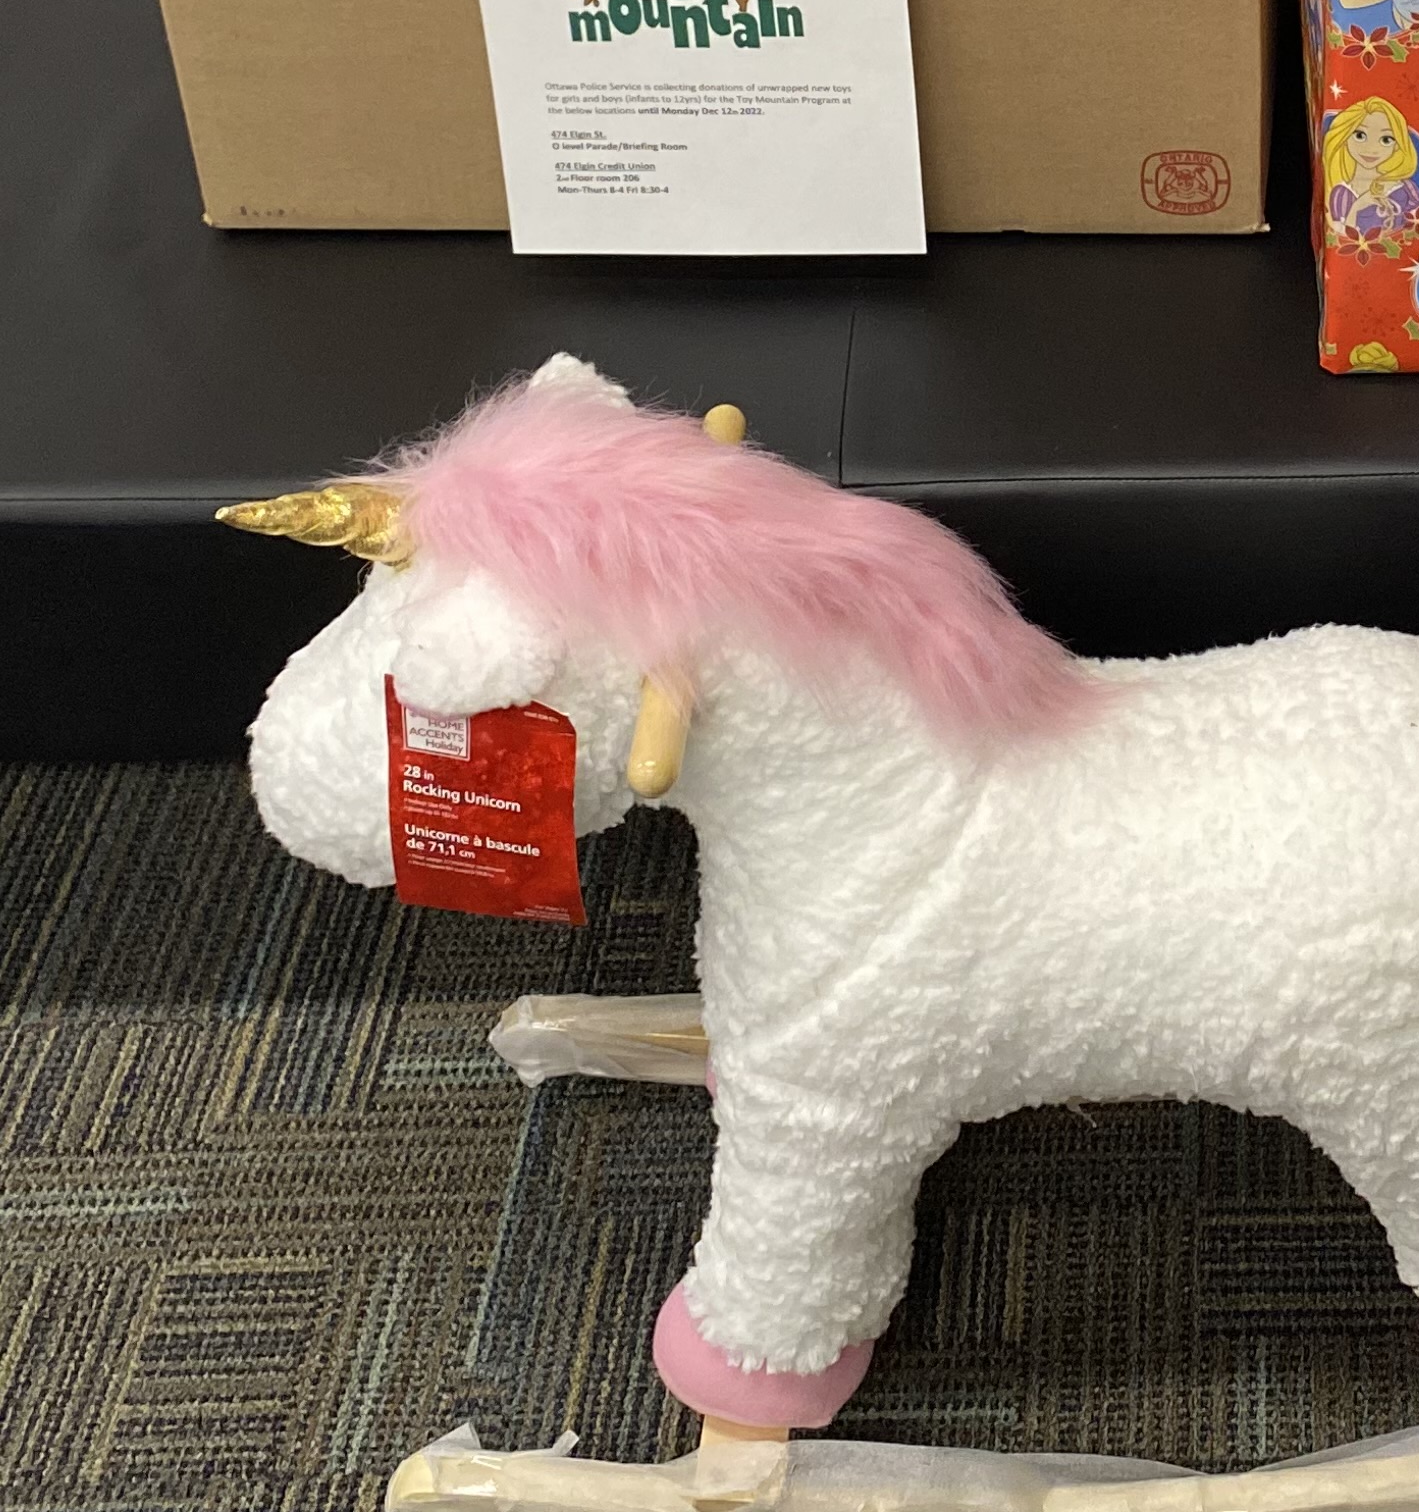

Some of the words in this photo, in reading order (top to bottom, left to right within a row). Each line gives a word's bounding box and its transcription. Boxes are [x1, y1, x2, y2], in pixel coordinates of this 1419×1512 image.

[544, 82, 578, 91] Ottawa
[580, 82, 607, 91] Police
[609, 83, 642, 91] Service
[644, 83, 652, 91] is
[653, 83, 697, 93] collecting
[699, 83, 744, 92] donations
[745, 83, 755, 92] of
[757, 84, 809, 93] unwrapped
[832, 85, 852, 94] toys
[546, 95, 559, 103] for
[561, 95, 580, 104] girls
[582, 95, 600, 103] and
[601, 95, 623, 104] boys
[625, 95, 660, 104] (infants
[674, 95, 702, 104] 12yrs)
[704, 95, 717, 103] for
[719, 95, 734, 103] the
[736, 96, 753, 105] Toy
[755, 96, 799, 104] Mountain
[801, 96, 840, 105] Program
[842, 97, 852, 105] at
[594, 107, 636, 115] locations
[638, 107, 660, 115] until
[661, 107, 700, 116] Monday
[551, 130, 568, 139] 474
[569, 130, 592, 140] Elgin
[593, 130, 608, 139] St.
[562, 142, 584, 150] level
[585, 142, 659, 152] Parade/Briefing
[660, 143, 688, 151] Room
[1159, 152, 1213, 164] ONTARIO
[554, 162, 572, 171] 474
[573, 162, 596, 171] Elgin
[597, 162, 625, 171] Credit
[627, 162, 656, 171] Union
[570, 174, 594, 182] Floor
[623, 174, 640, 182] 206
[557, 186, 608, 194] Mon-Thurs
[626, 186, 638, 194] Fri
[427, 718, 465, 732] HOME
[409, 726, 465, 743] ACCENTS
[425, 738, 464, 756] Holiday
[403, 764, 421, 779] 28
[423, 769, 435, 781] in
[403, 780, 461, 804] Rocking
[464, 791, 521, 813] Unicorn
[404, 823, 469, 845] Unicorne
[473, 832, 482, 847] à
[486, 836, 541, 857] bascule
[405, 838, 425, 851] de
[427, 840, 456, 856] 71,1
[459, 848, 476, 859] cm
